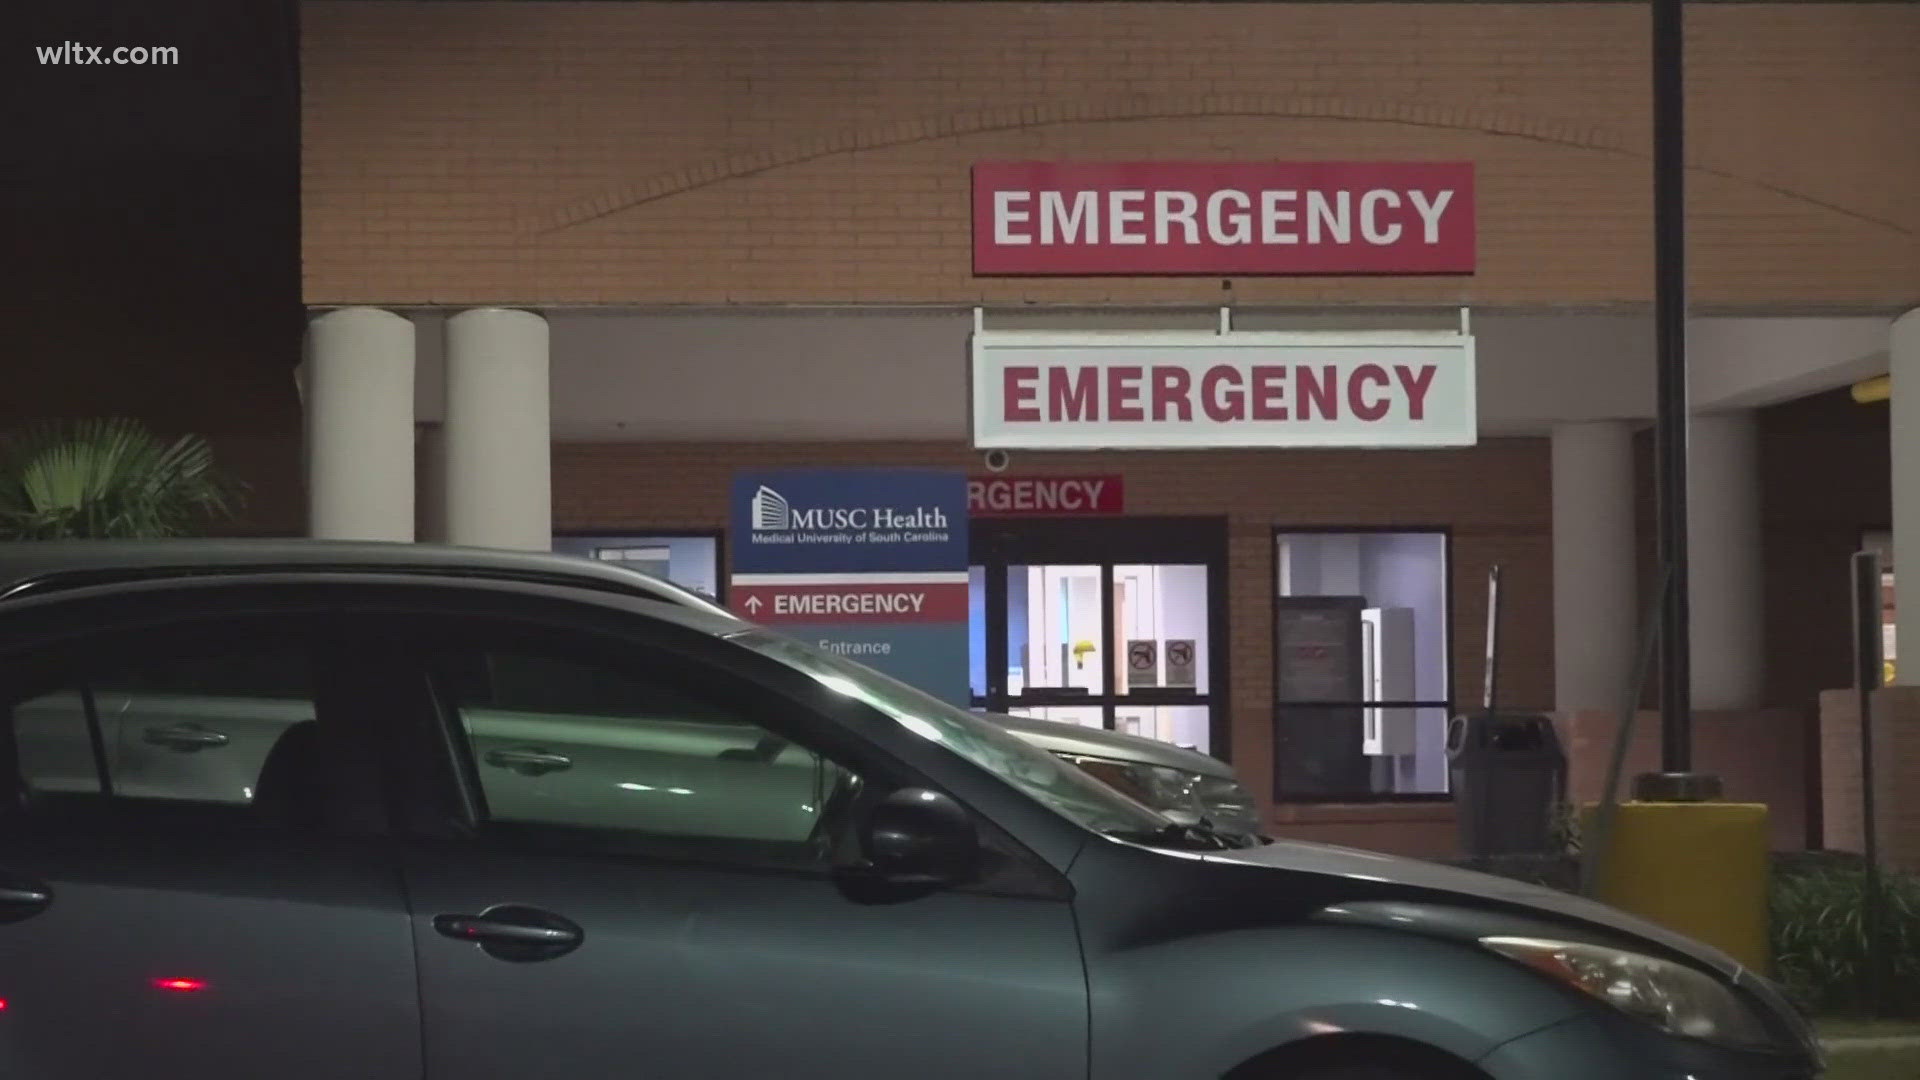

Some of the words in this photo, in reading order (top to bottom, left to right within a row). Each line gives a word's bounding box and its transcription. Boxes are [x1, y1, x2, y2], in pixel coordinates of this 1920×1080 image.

[993, 189, 1454, 246] EMERGENCY
[1003, 364, 1437, 423] EMERGENCY
[967, 480, 1104, 511] RGENCY
[791, 508, 867, 529] MUSC
[873, 506, 947, 529] Health
[752, 532, 794, 544] Medical
[797, 531, 851, 545] University
[854, 531, 866, 543] of
[868, 531, 901, 543] South
[904, 530, 949, 543] Carolina
[774, 593, 924, 615] EMERGENCY
